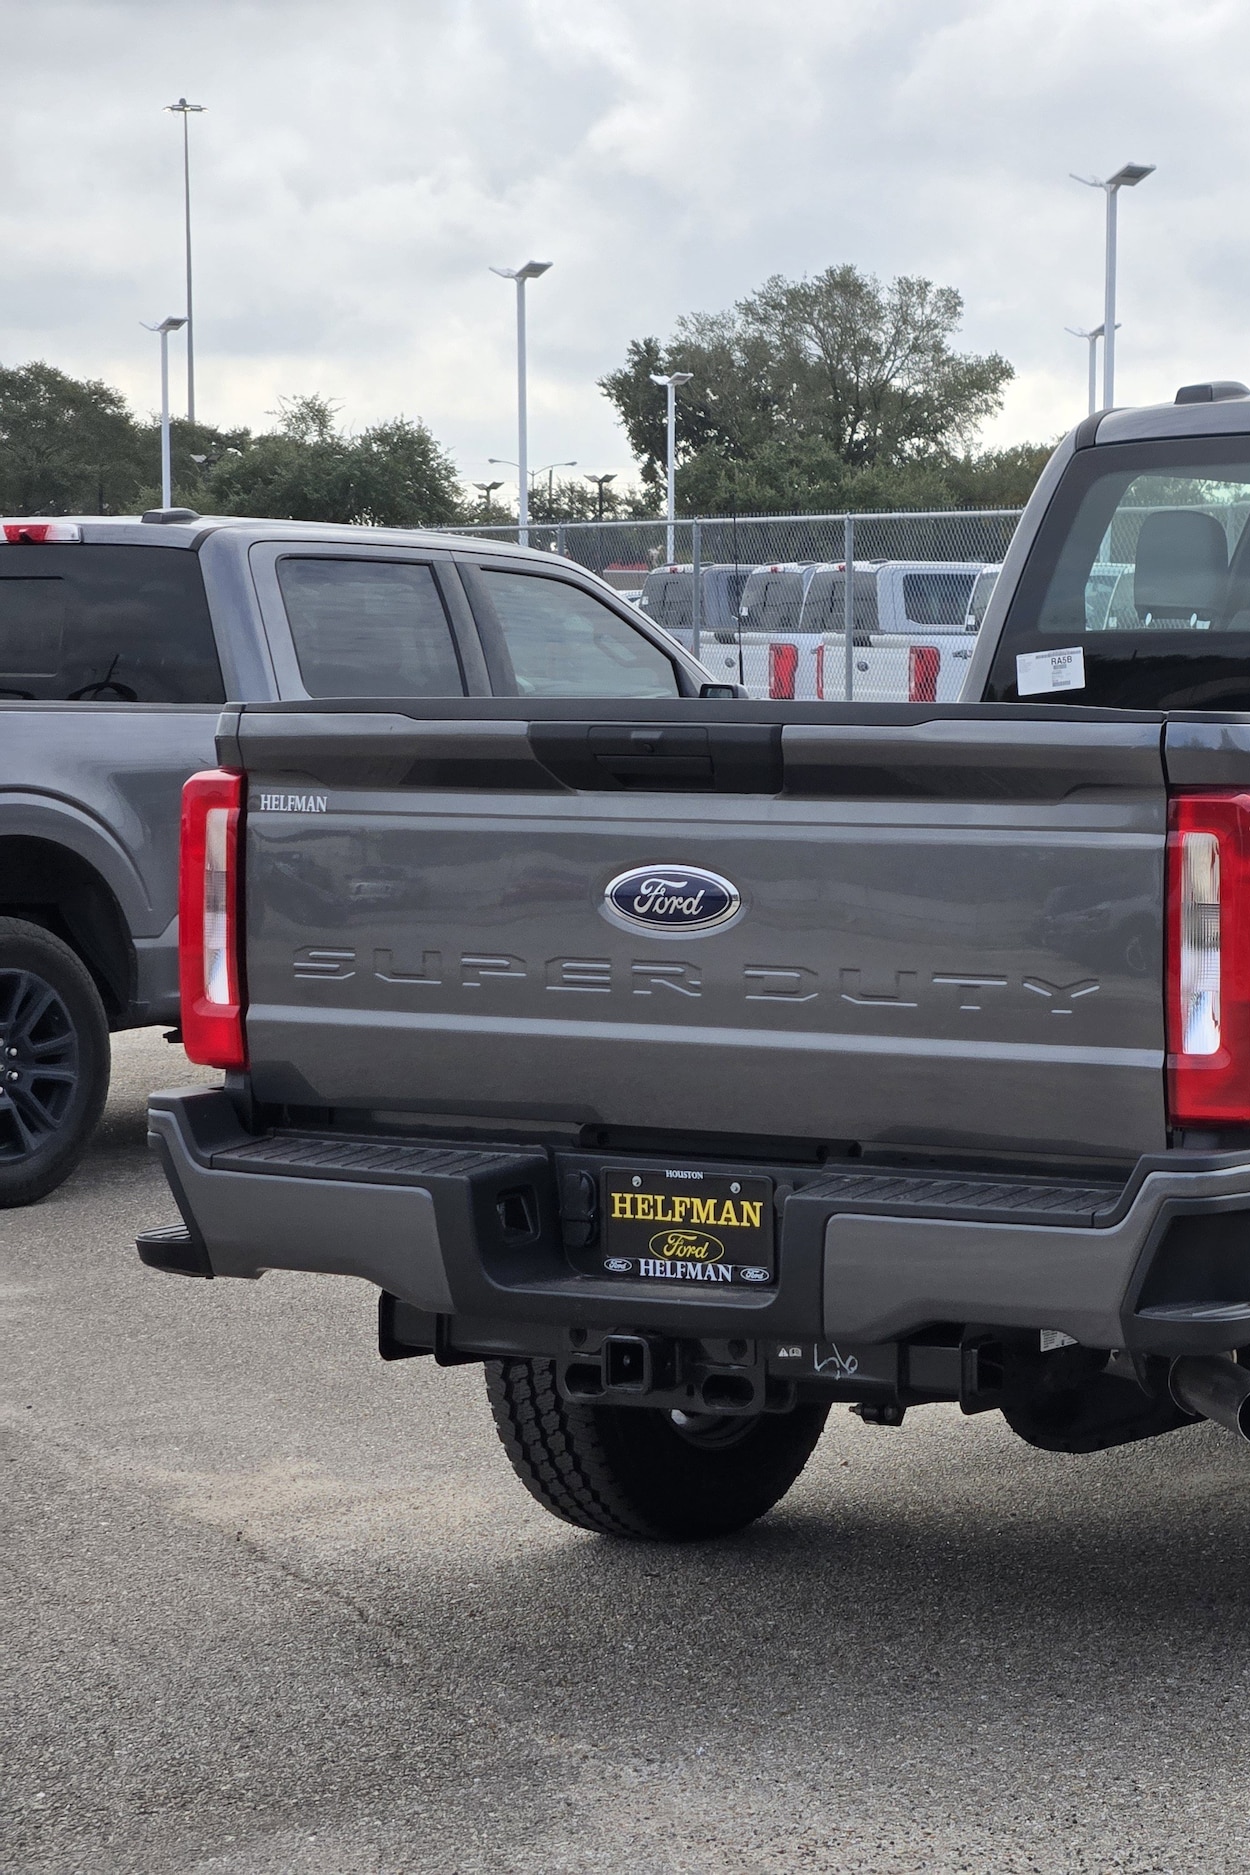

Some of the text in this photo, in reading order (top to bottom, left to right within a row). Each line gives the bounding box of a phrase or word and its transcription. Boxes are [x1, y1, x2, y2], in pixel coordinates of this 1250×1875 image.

[1050, 655, 1072, 665] RA5B
[260, 793, 328, 813] HELFMAN
[633, 877, 706, 916] Ford
[293, 945, 1101, 1015] SUPER DUTY
[665, 1169, 704, 1180] HOUSTON
[611, 1192, 763, 1228] HELFMAN
[663, 1232, 710, 1259] Ford
[608, 1259, 629, 1271] Ford
[638, 1258, 733, 1283] HELFMAN
[745, 1269, 766, 1281] Ford
